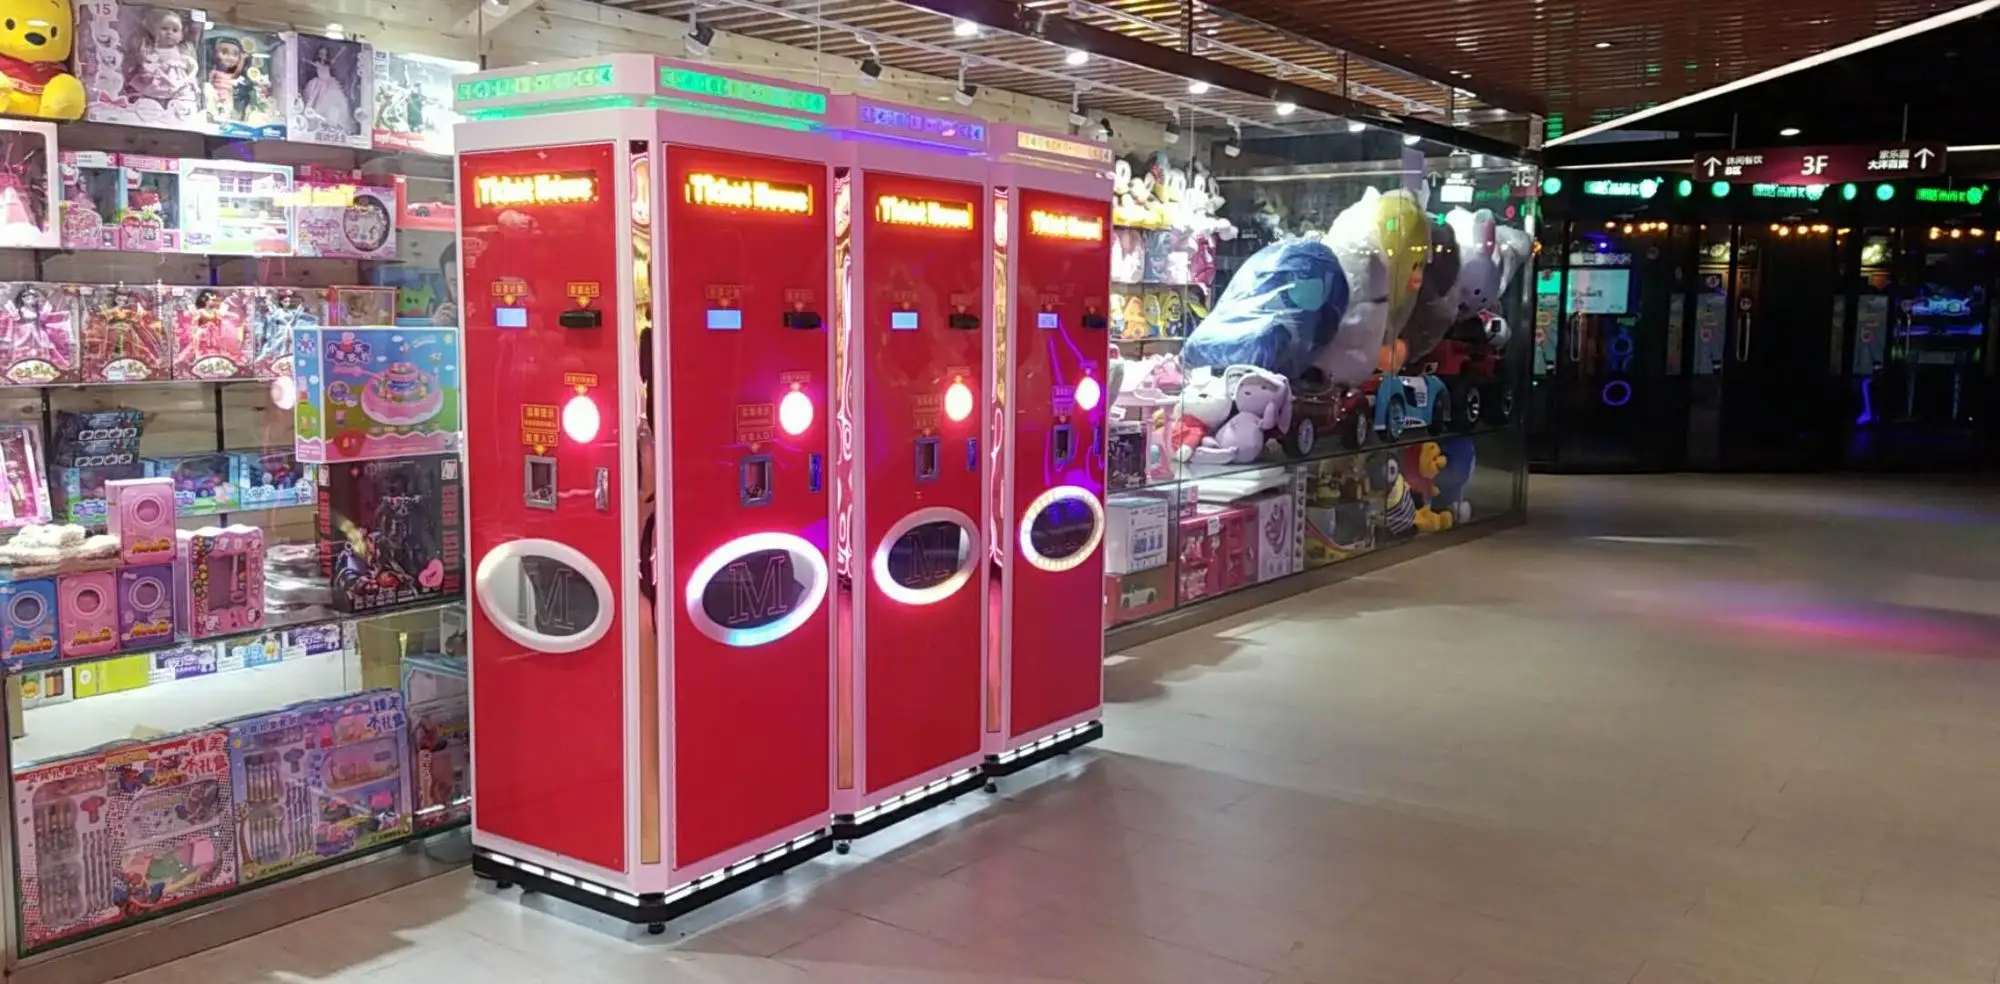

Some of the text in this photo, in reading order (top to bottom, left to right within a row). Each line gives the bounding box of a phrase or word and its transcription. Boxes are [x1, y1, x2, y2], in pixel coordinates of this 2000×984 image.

[94, 3, 112, 16] 15
[1801, 155, 1830, 176] 3F
[517, 561, 576, 632] M
[728, 555, 788, 625] M
